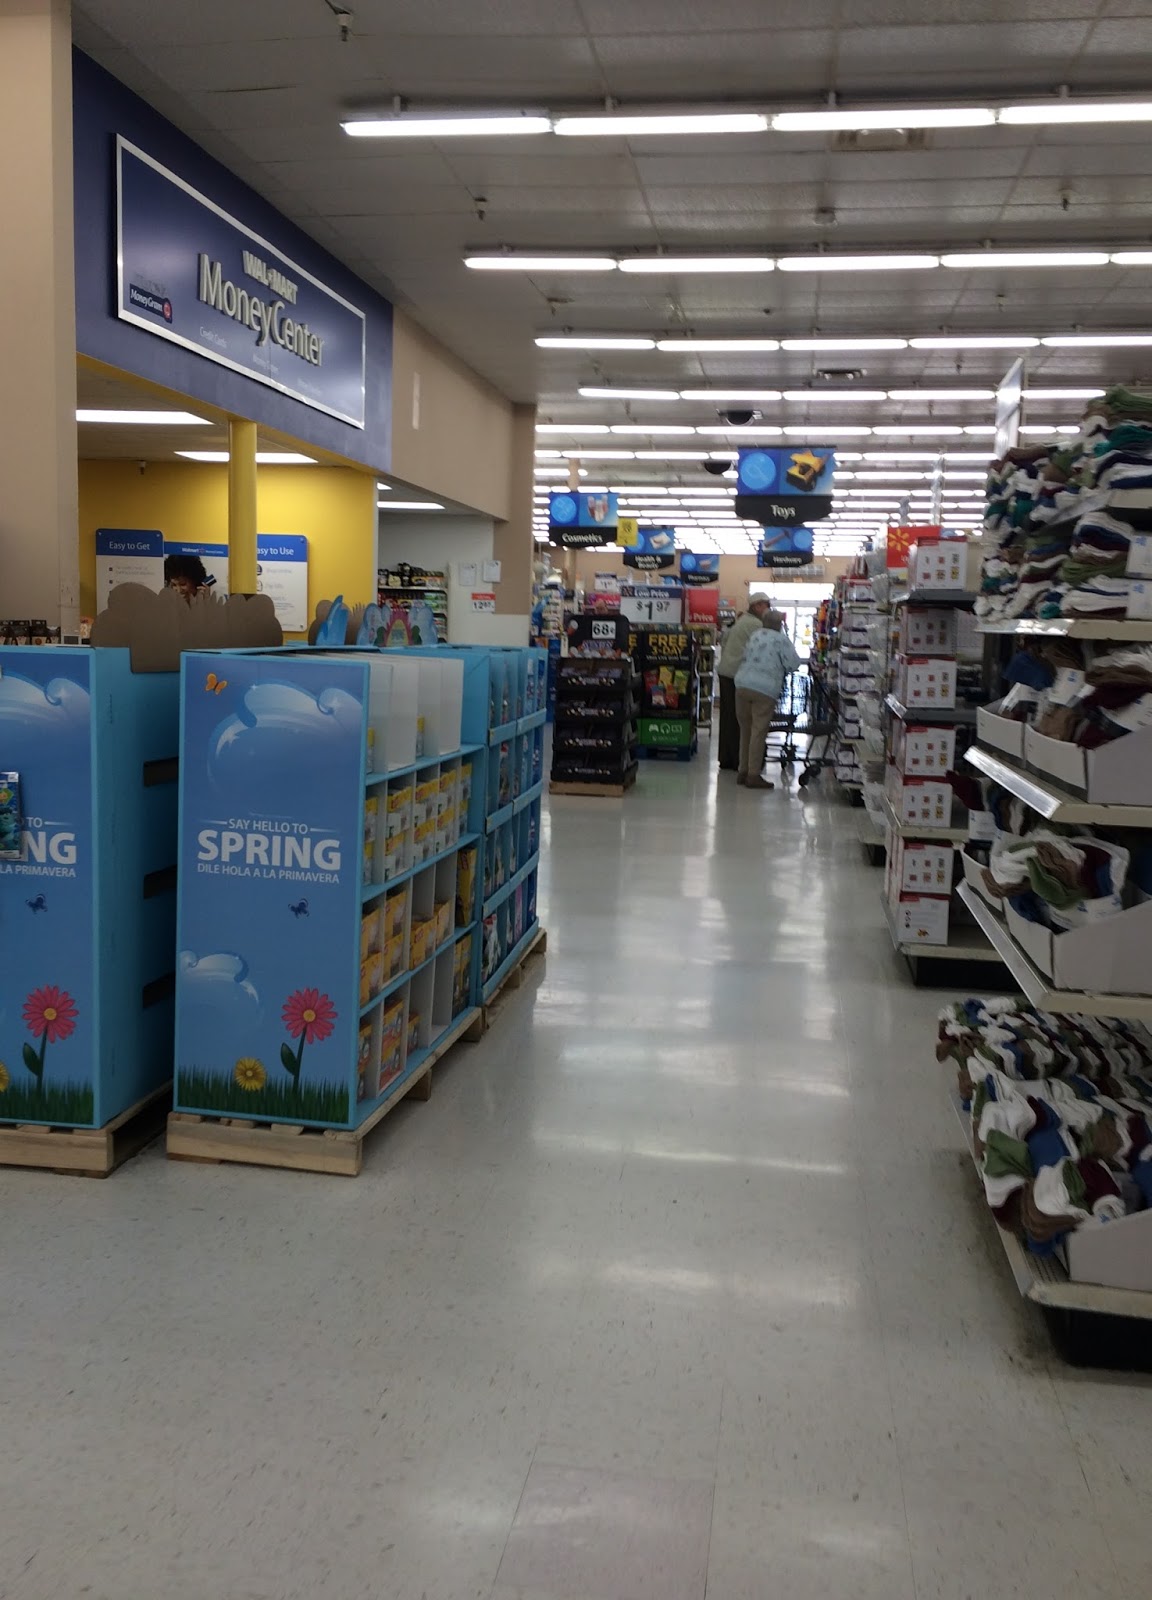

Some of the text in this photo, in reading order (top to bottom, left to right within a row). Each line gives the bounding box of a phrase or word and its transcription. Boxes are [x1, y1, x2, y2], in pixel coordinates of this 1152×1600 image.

[130, 288, 163, 313] MoneyGram
[199, 252, 324, 366] MoneyCenter
[770, 504, 796, 520] Toys
[562, 532, 603, 543] Cosmetics
[109, 541, 150, 552] Easy to Get
[257, 546, 294, 556] asy to Use
[635, 555, 655, 563] Health
[634, 589, 670, 598] Low Price
[693, 613, 714, 622] Price
[648, 633, 688, 647] FREE
[26, 816, 43, 828] TO
[228, 818, 308, 835] SAY HELLO TO
[197, 829, 341, 871] SPRING
[15, 864, 77, 878] PRIMAVERA
[197, 863, 340, 884] DILE HOLA A LA PRIMAVERA
